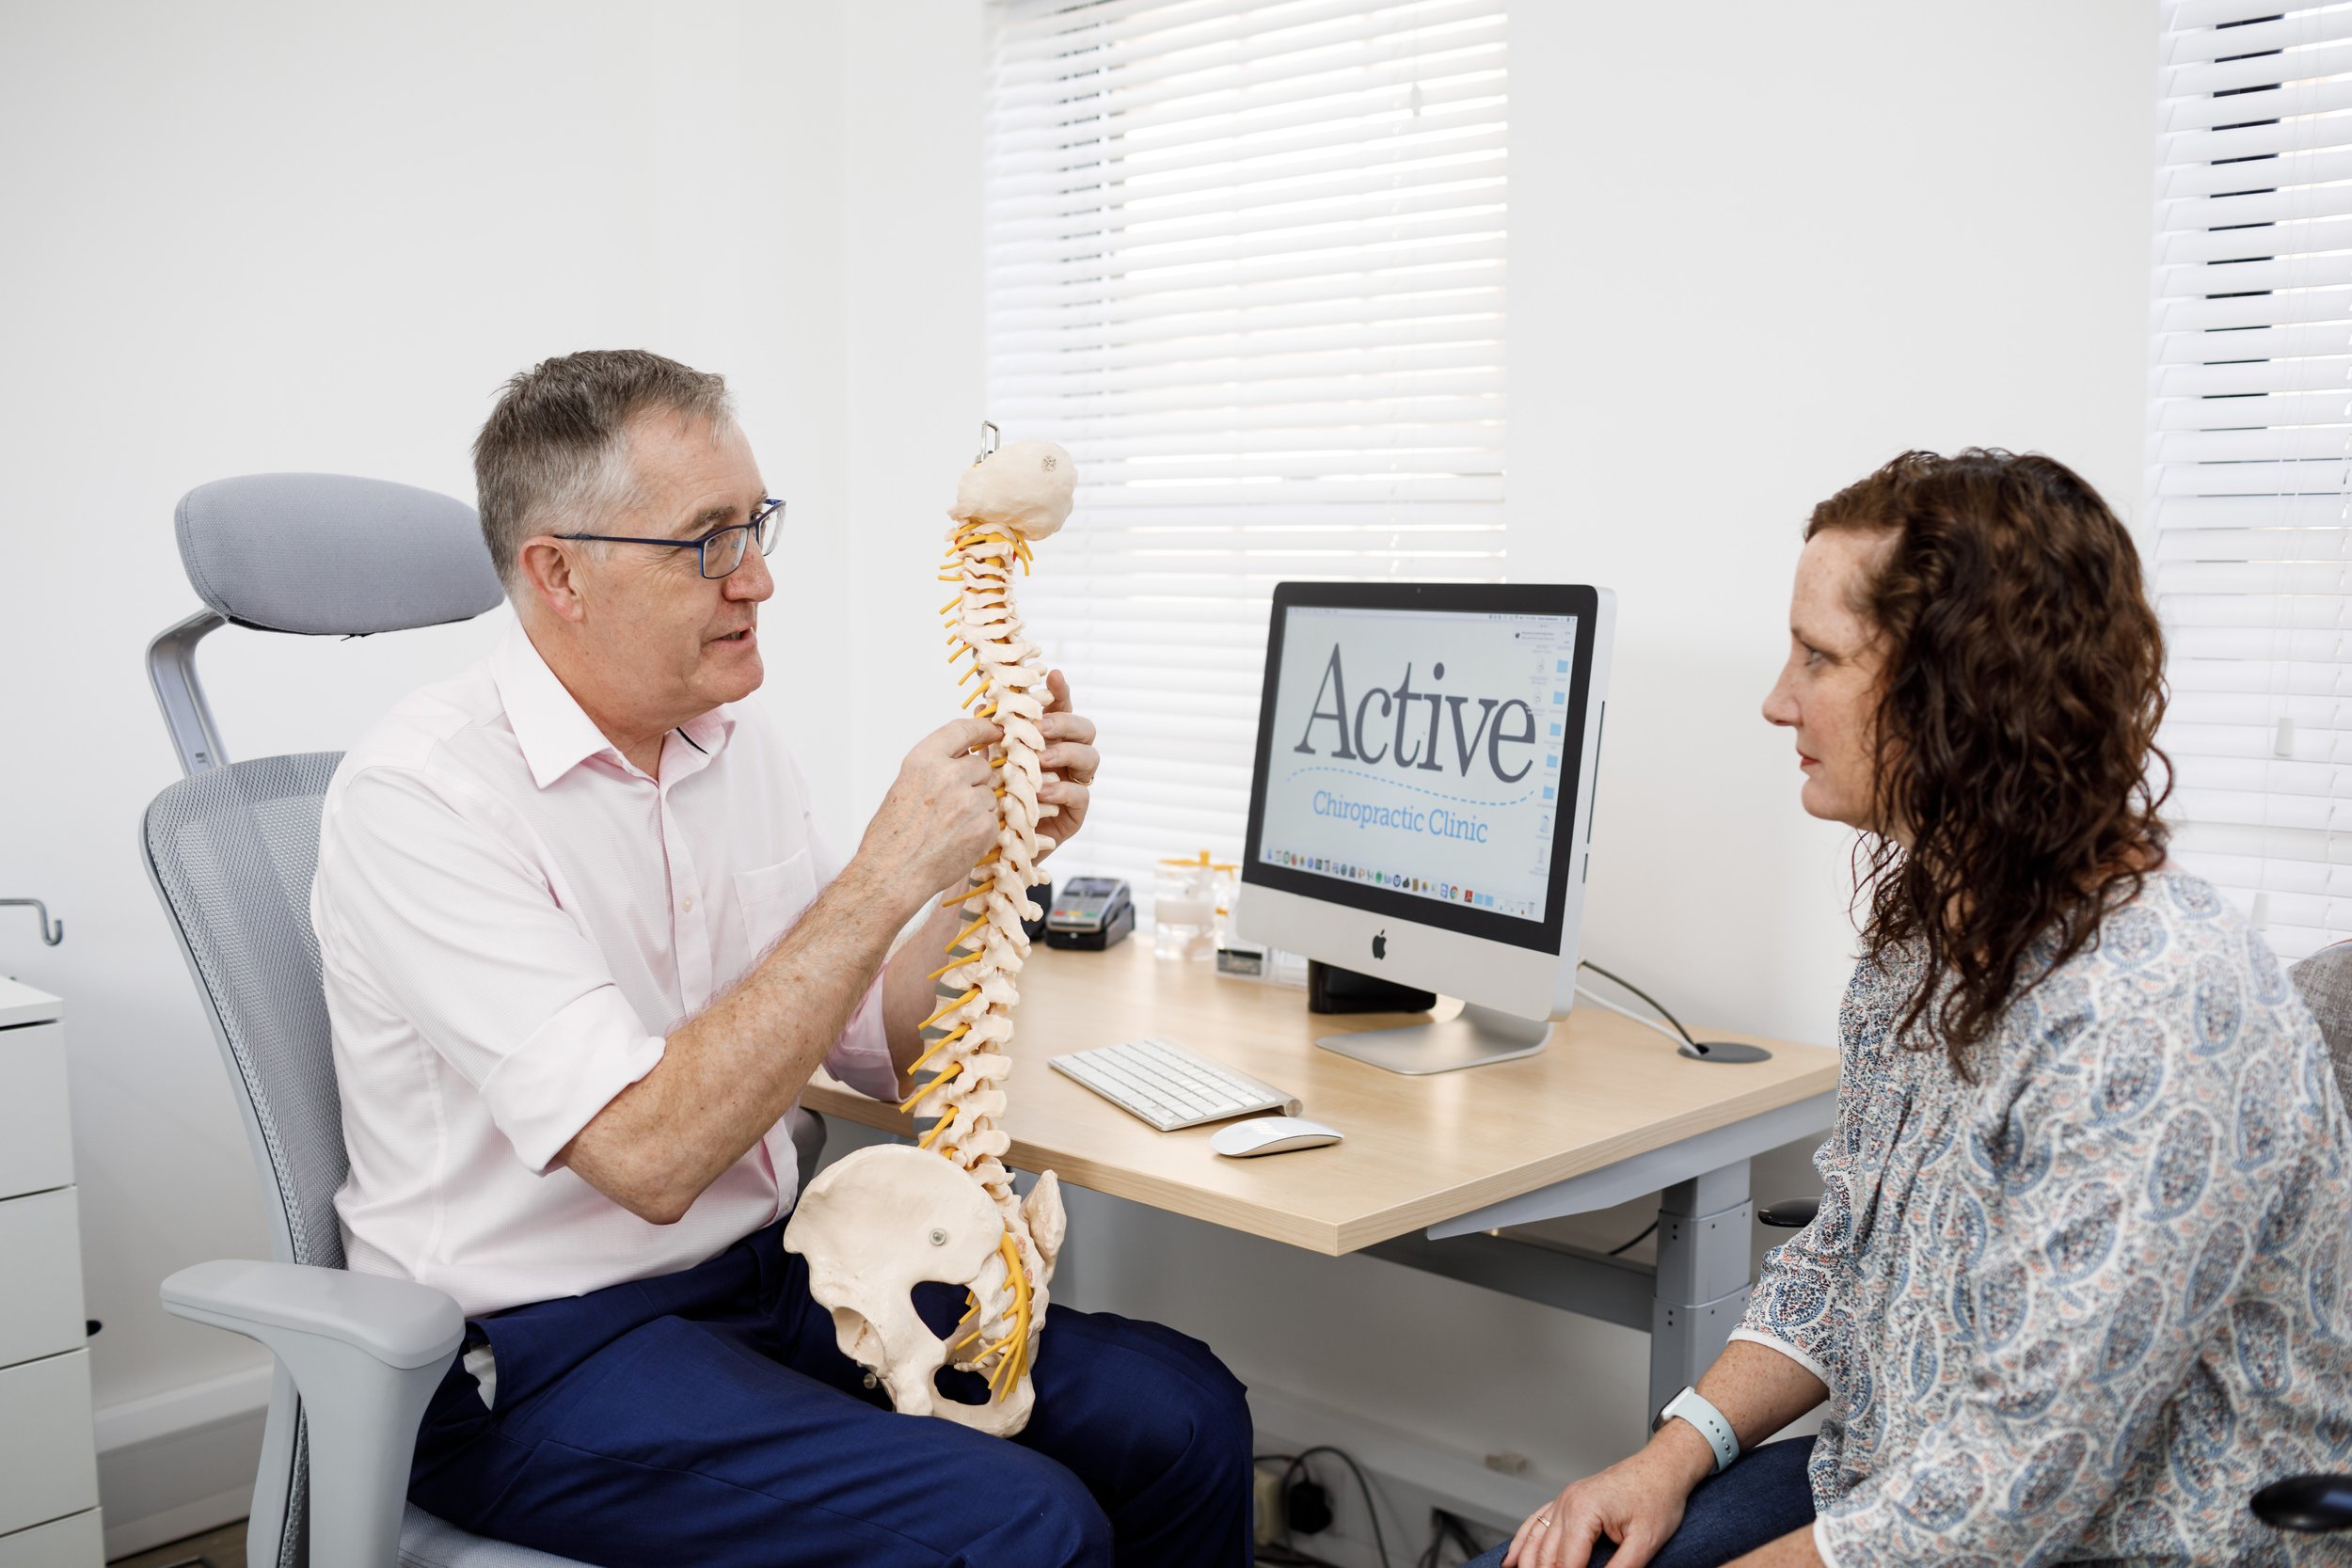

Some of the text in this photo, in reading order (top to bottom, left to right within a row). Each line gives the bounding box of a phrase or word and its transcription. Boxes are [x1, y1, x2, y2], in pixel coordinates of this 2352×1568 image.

[1294, 642, 1536, 784] Active
[1313, 790, 1488, 844] Chiropractic Clinic
